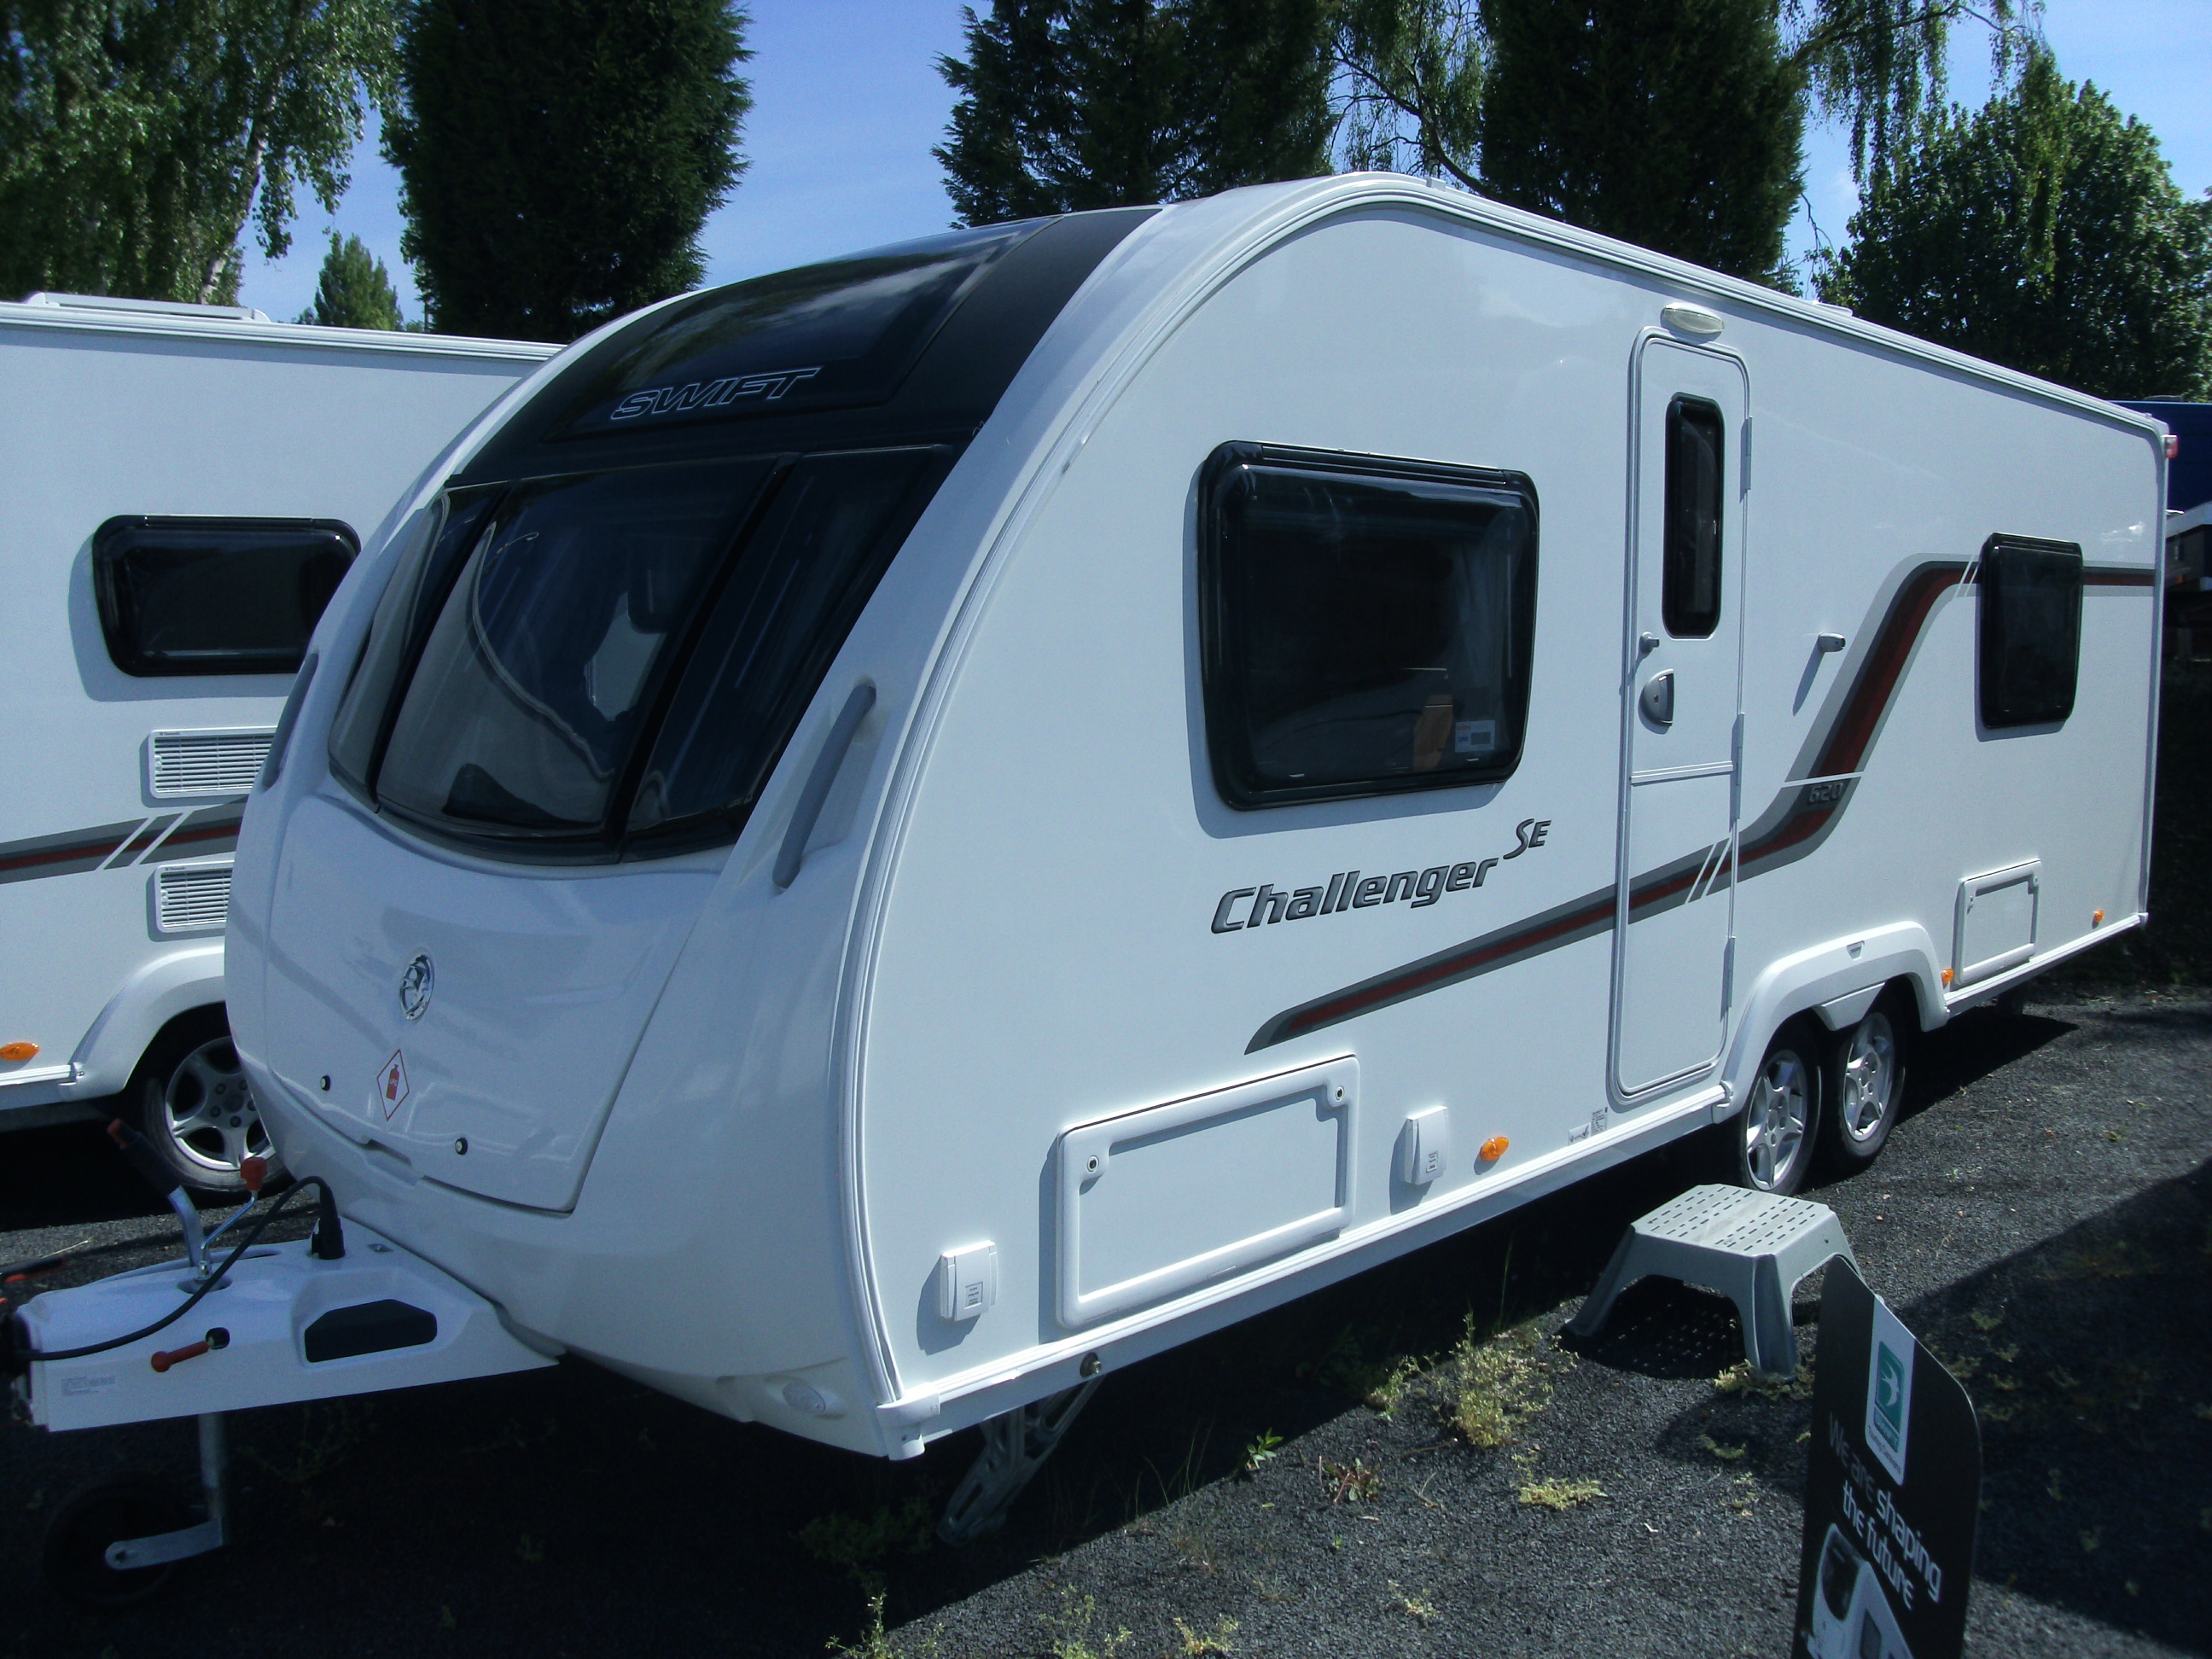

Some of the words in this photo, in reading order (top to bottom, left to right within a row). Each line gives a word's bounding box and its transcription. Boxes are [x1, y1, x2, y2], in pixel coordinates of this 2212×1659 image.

[610, 367, 822, 420] SWIFT
[1809, 783, 1844, 803] 620
[1210, 857, 1499, 934] Challenger
[1502, 818, 1551, 860] SE
[1842, 1479, 1866, 1539] the
[1866, 1516, 1916, 1611] future
[1850, 1452, 1876, 1502] are
[1876, 1487, 1943, 1604] shaping
